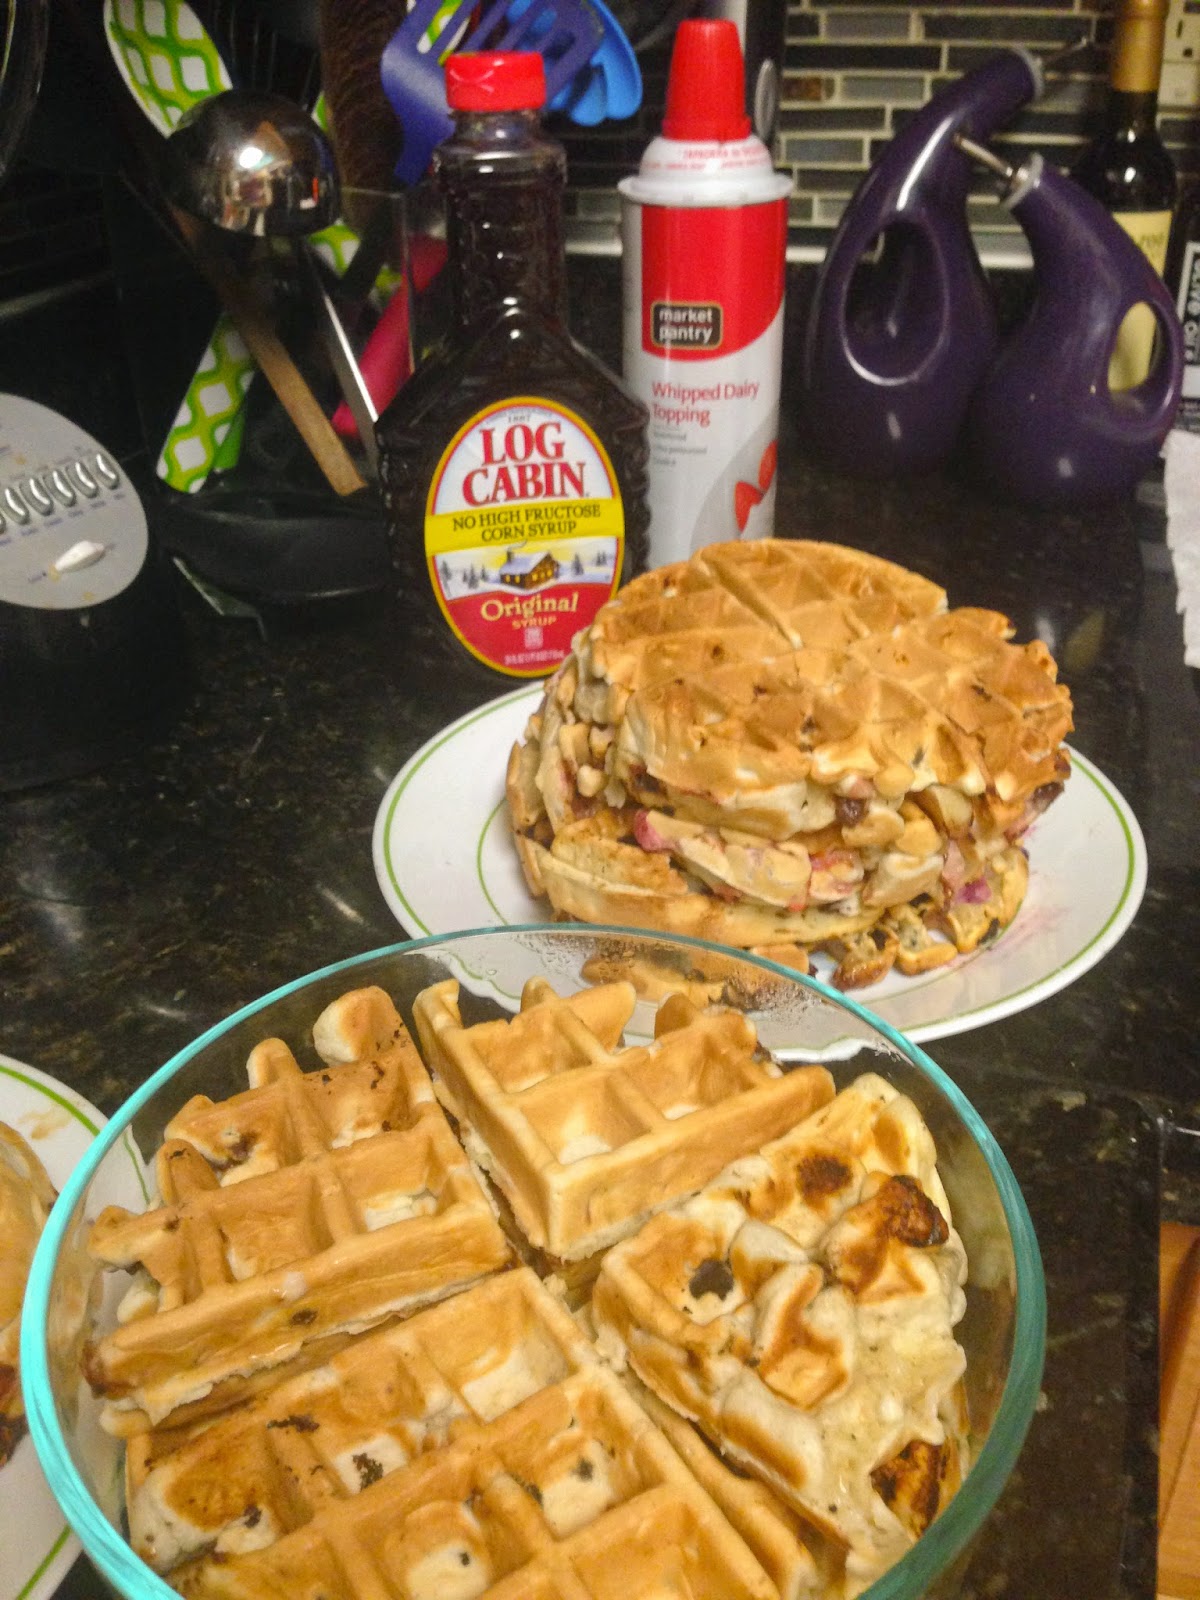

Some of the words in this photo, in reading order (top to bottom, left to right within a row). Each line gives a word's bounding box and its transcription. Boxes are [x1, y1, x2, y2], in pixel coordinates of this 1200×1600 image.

[659, 308, 712, 323] market
[659, 324, 713, 344] pantry
[652, 381, 720, 405] Whipped
[724, 379, 759, 402] Dairy
[653, 403, 710, 428] Topping
[479, 422, 565, 466] LOG
[462, 462, 586, 507] CABIN
[453, 516, 476, 531] NO
[479, 510, 521, 529] HIGH
[525, 504, 601, 522] FRUCTOSE
[481, 524, 525, 542] CORN
[528, 520, 577, 538] SYRUP
[480, 592, 579, 622] Original
[511, 616, 557, 630] SYRUP
